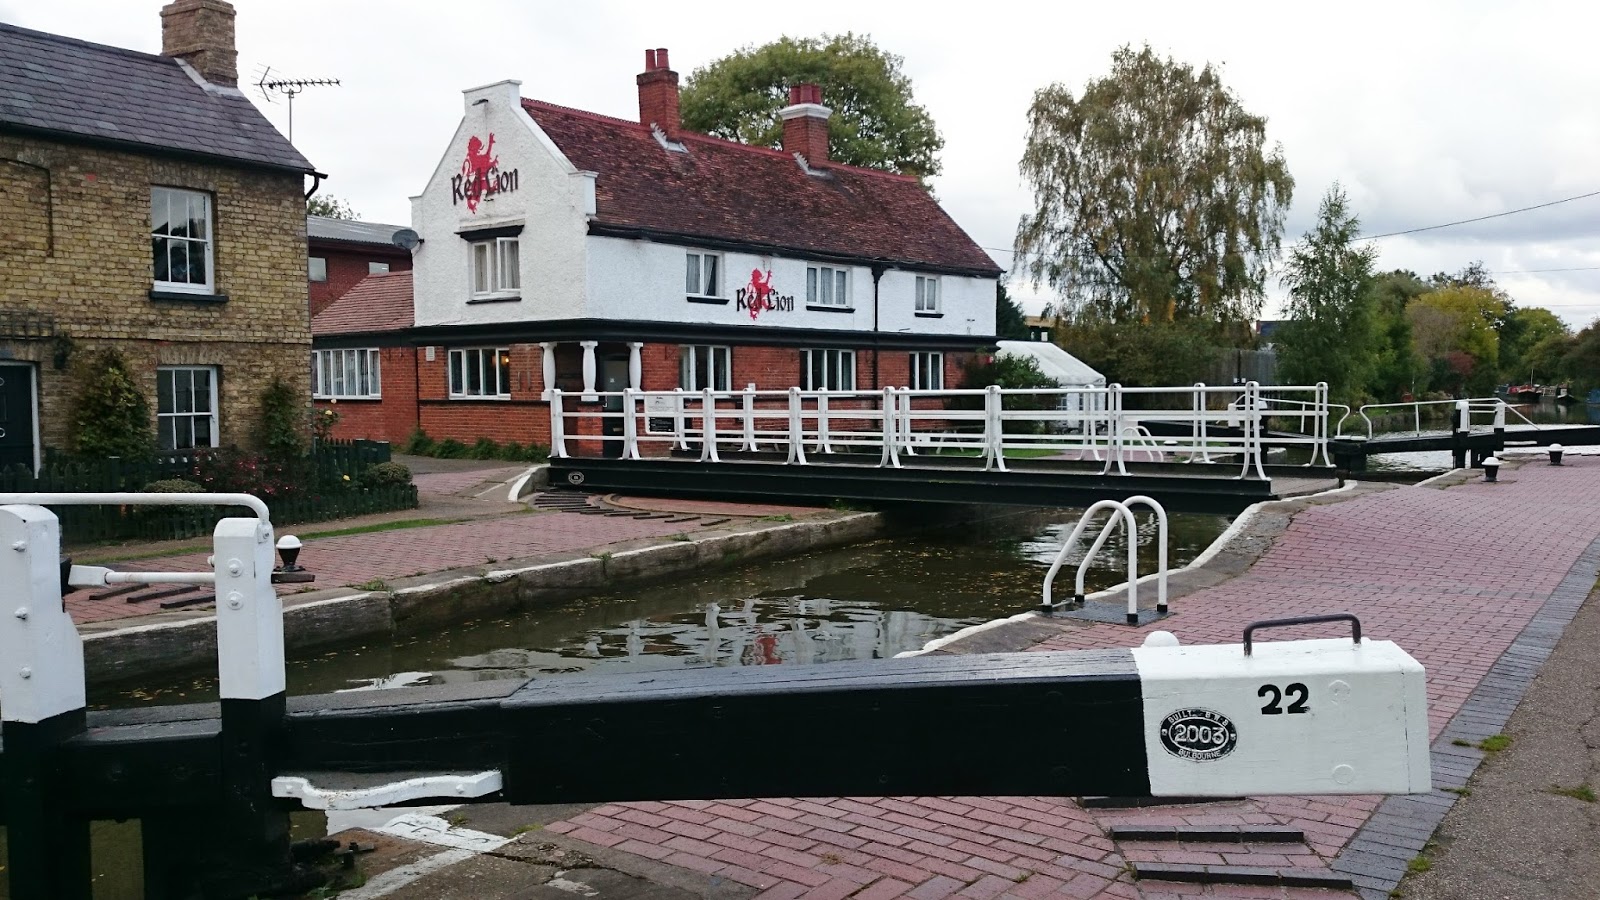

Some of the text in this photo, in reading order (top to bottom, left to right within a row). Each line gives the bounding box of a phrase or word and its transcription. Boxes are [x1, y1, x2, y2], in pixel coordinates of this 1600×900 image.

[451, 165, 519, 206] Red Lion
[736, 287, 794, 312] Red Lion
[1257, 682, 1311, 715] 22
[1168, 710, 1192, 723] BUILT
[1174, 723, 1225, 744] 2003
